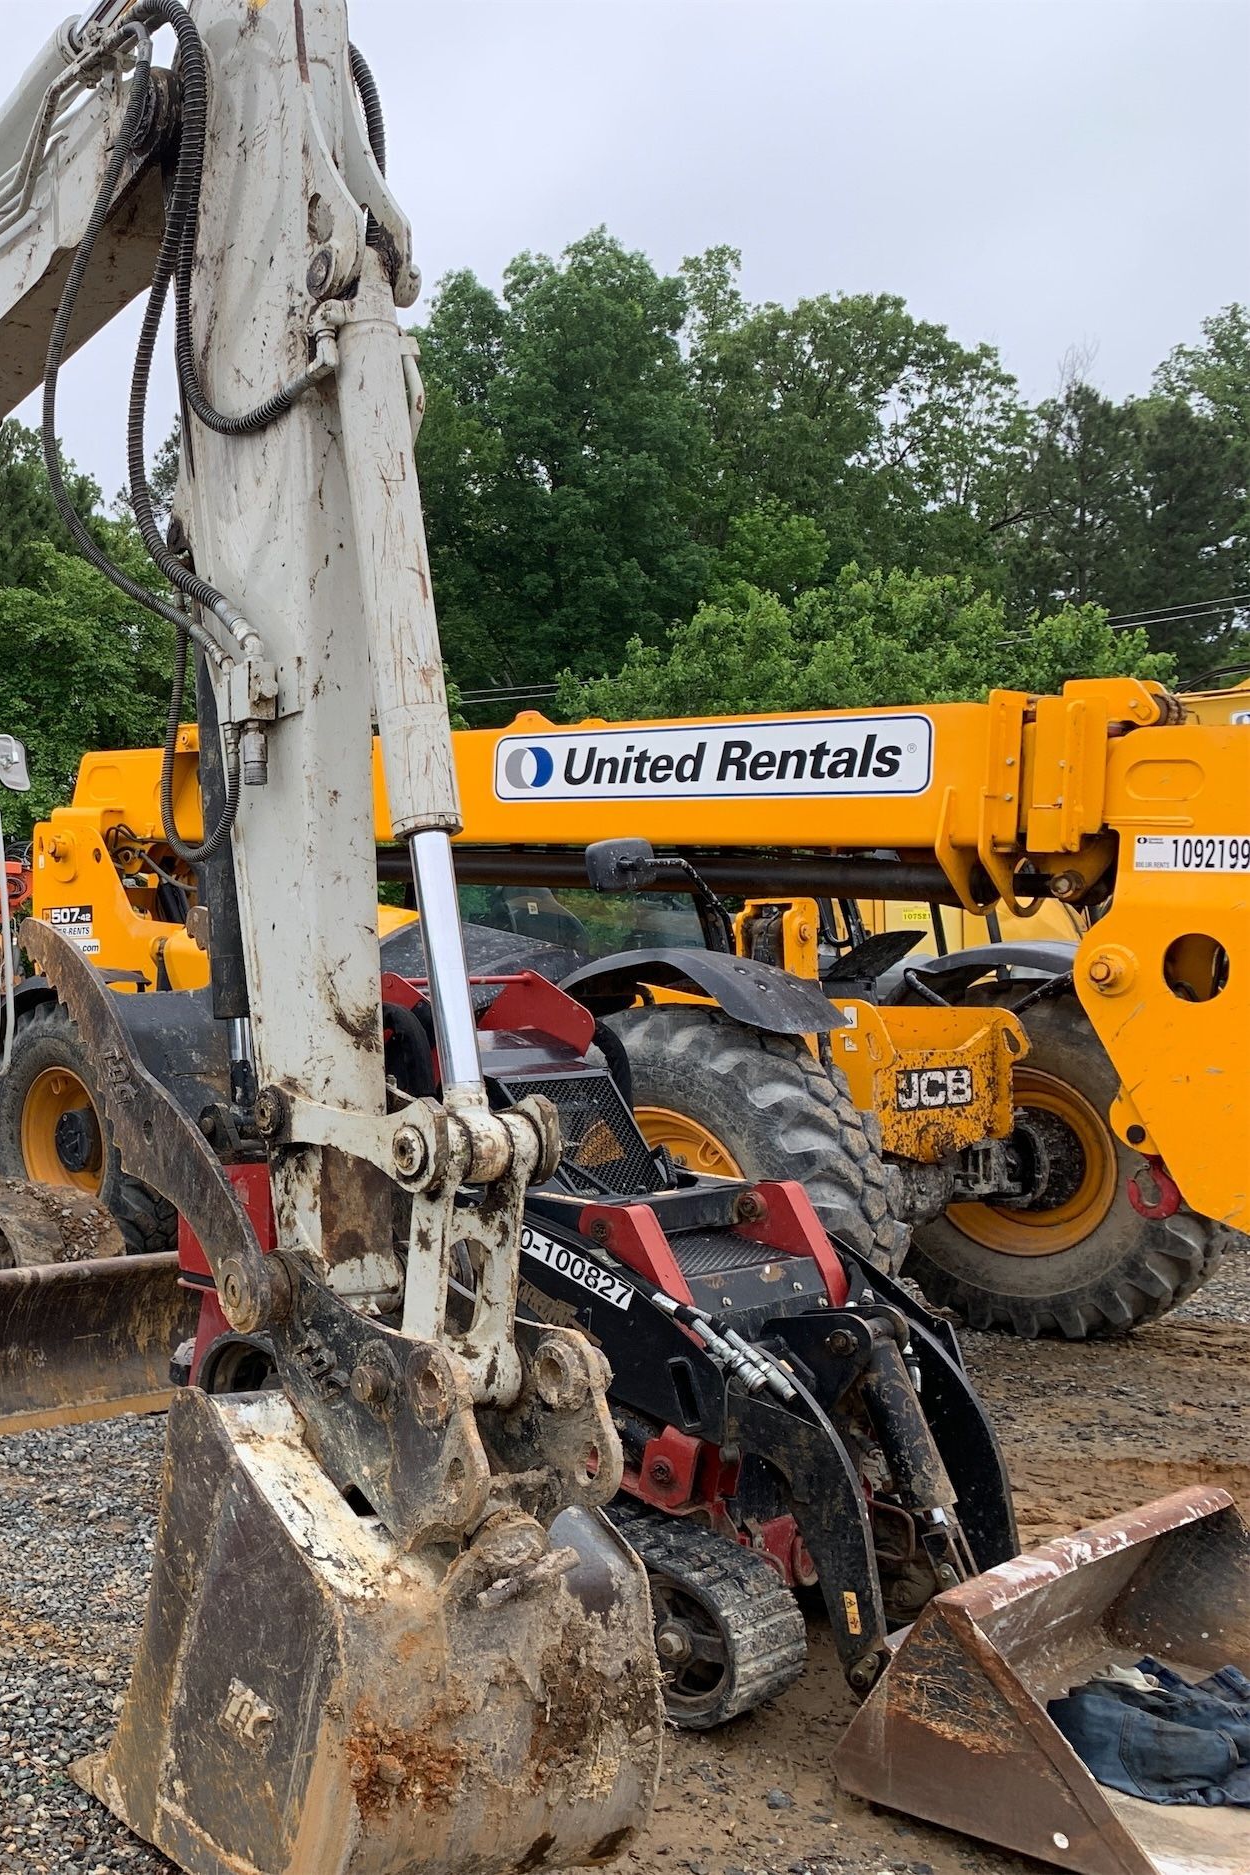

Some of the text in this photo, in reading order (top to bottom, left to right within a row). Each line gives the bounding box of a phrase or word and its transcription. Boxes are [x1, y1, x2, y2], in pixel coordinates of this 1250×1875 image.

[564, 733, 901, 786] United Rentals
[1172, 838, 1250, 869] 1092199
[62, 926, 90, 937] R-RENTS
[80, 944, 99, 952] com
[897, 1070, 972, 1109] JCB
